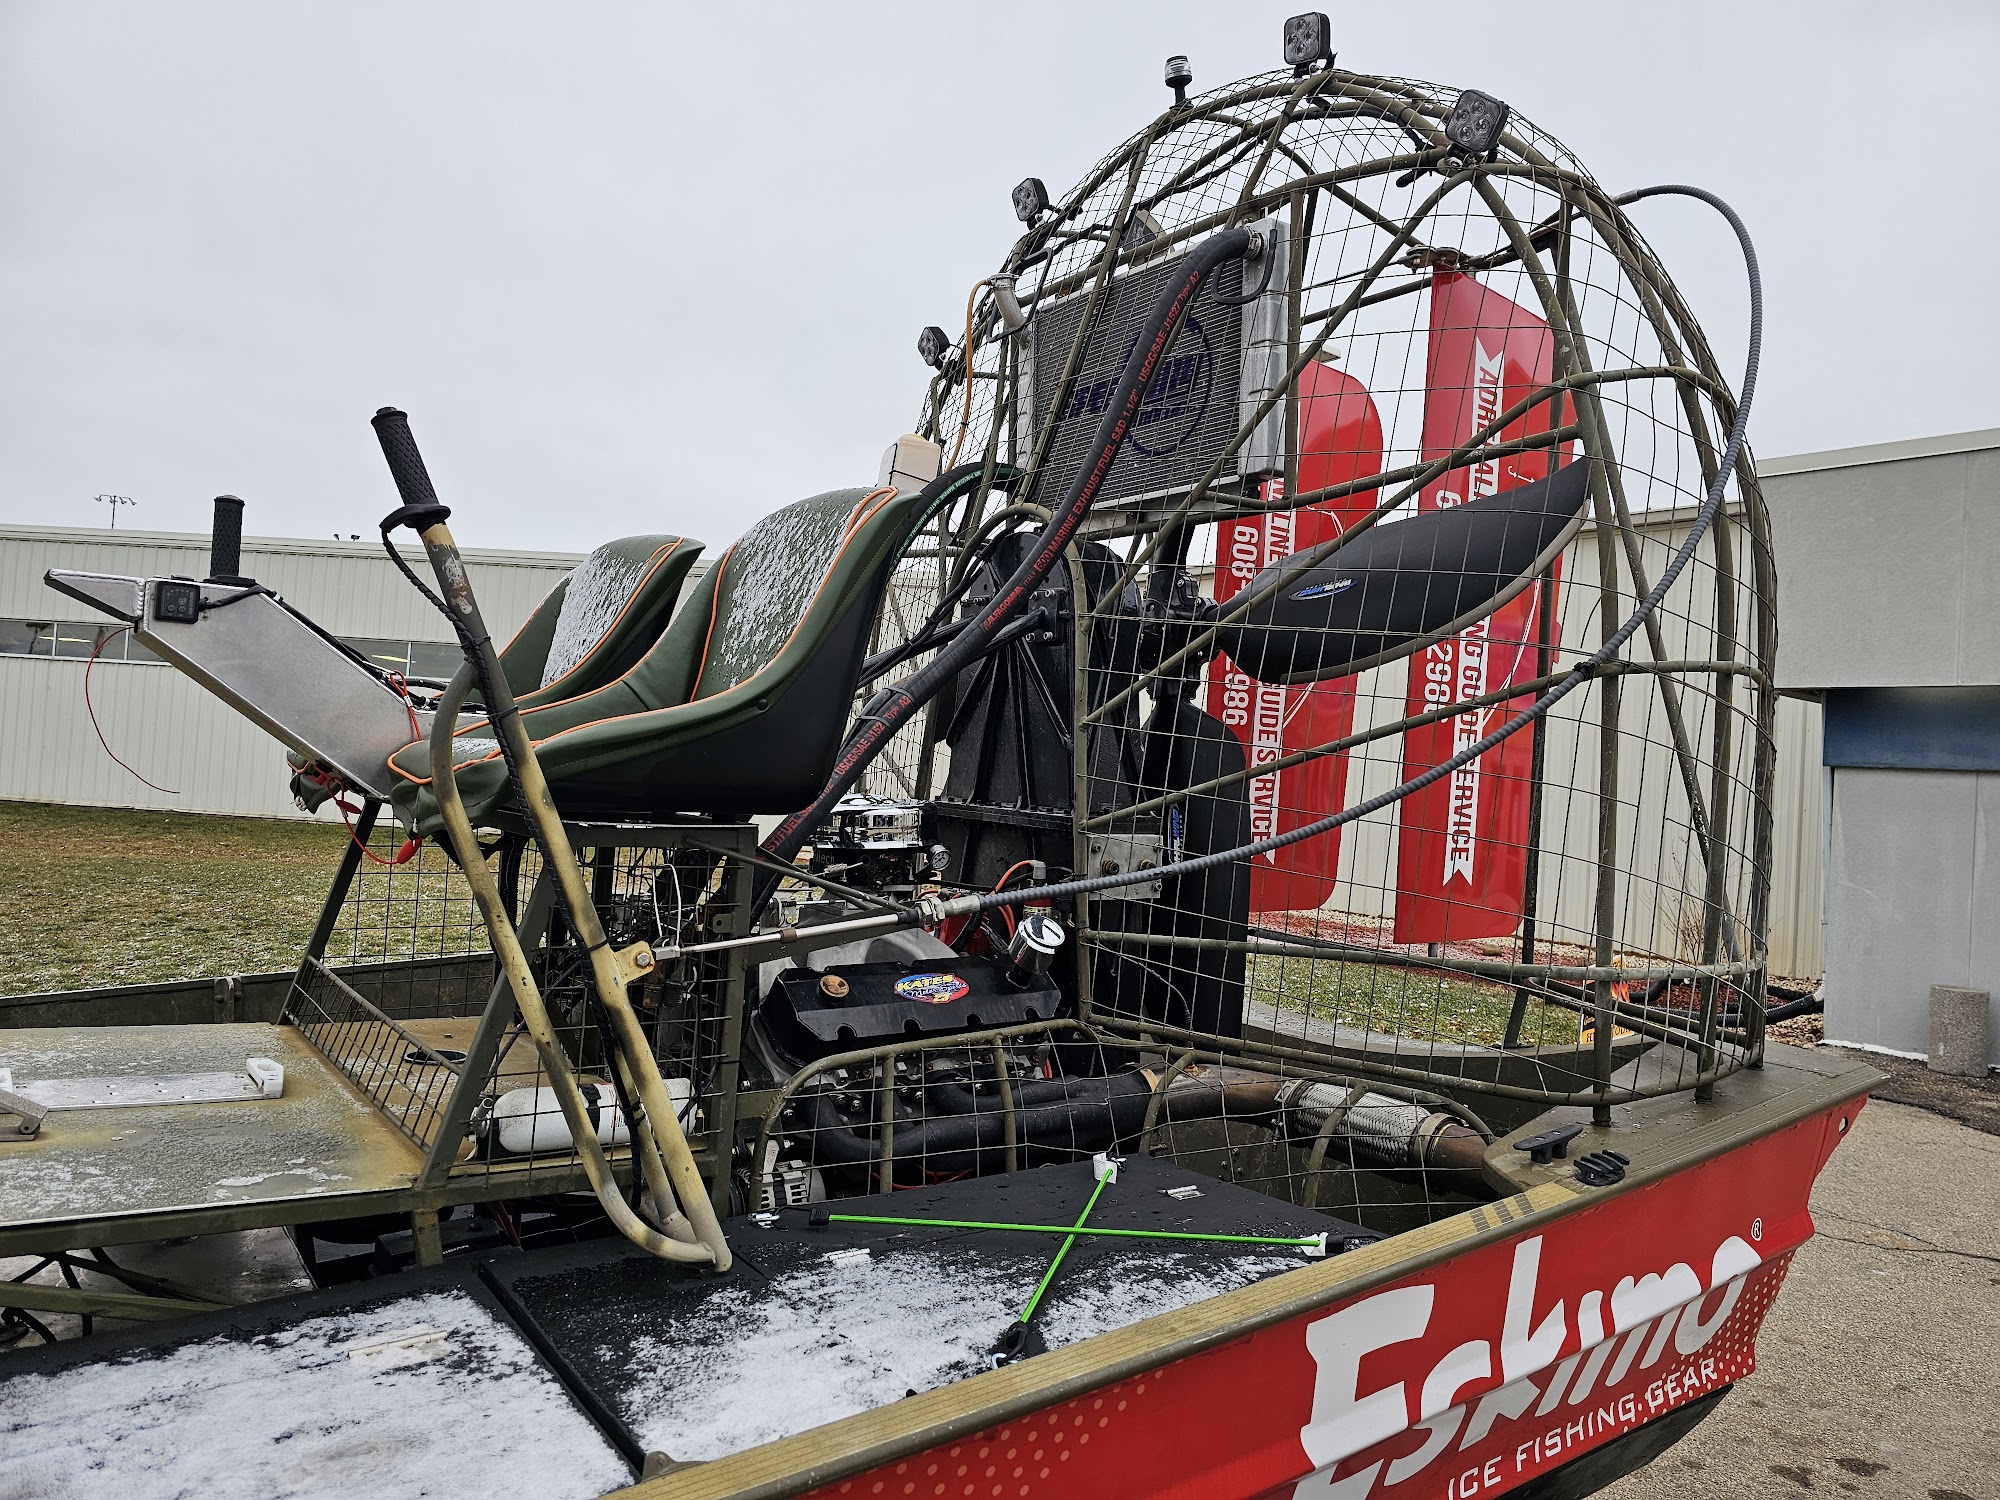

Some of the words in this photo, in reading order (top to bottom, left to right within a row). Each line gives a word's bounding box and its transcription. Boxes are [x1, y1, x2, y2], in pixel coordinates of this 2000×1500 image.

[1048, 514, 1076, 553] MARINE
[1072, 444, 1116, 515] EXHAUST/FUEL
[1111, 419, 1127, 441] S&D
[1138, 331, 1166, 382] USCG/SAE
[1164, 301, 1180, 331] J1527
[1177, 284, 1191, 300] Type
[1189, 270, 1200, 286] A2
[835, 737, 871, 777] USCG/SAE
[867, 721, 885, 742] J152
[884, 705, 900, 720] Type
[899, 695, 912, 709] A2
[897, 974, 954, 992] KATES
[1448, 1456, 1502, 1500] ICE
[1516, 1393, 1636, 1472] FISHING
[1648, 1357, 1719, 1408] GEAR
